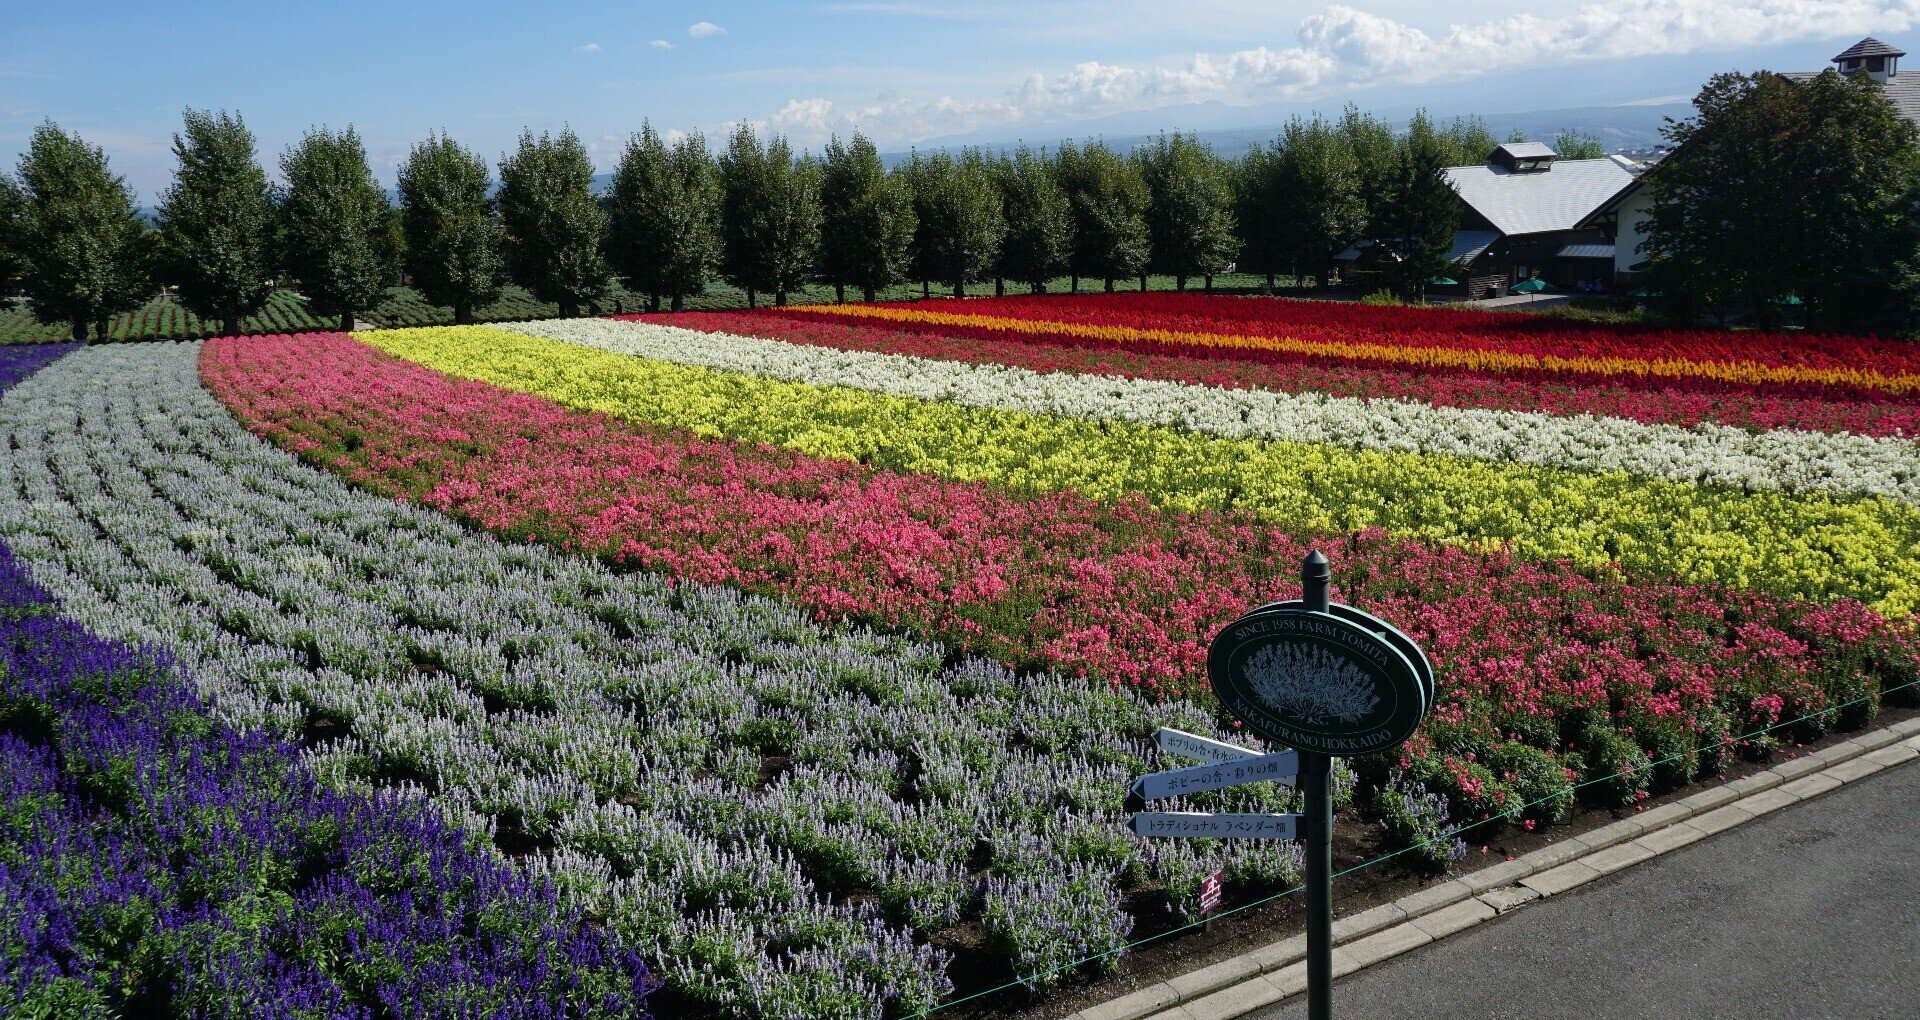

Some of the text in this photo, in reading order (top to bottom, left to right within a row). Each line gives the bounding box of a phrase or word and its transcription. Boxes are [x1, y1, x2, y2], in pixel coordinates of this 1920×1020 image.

[1235, 619, 1389, 667] SINCE 1958 FARM TOMITA
[1233, 698, 1392, 750] NAKAFURANO HOKKAIDO
[1149, 819, 1286, 833] トラディショナル ラベンダー畑
